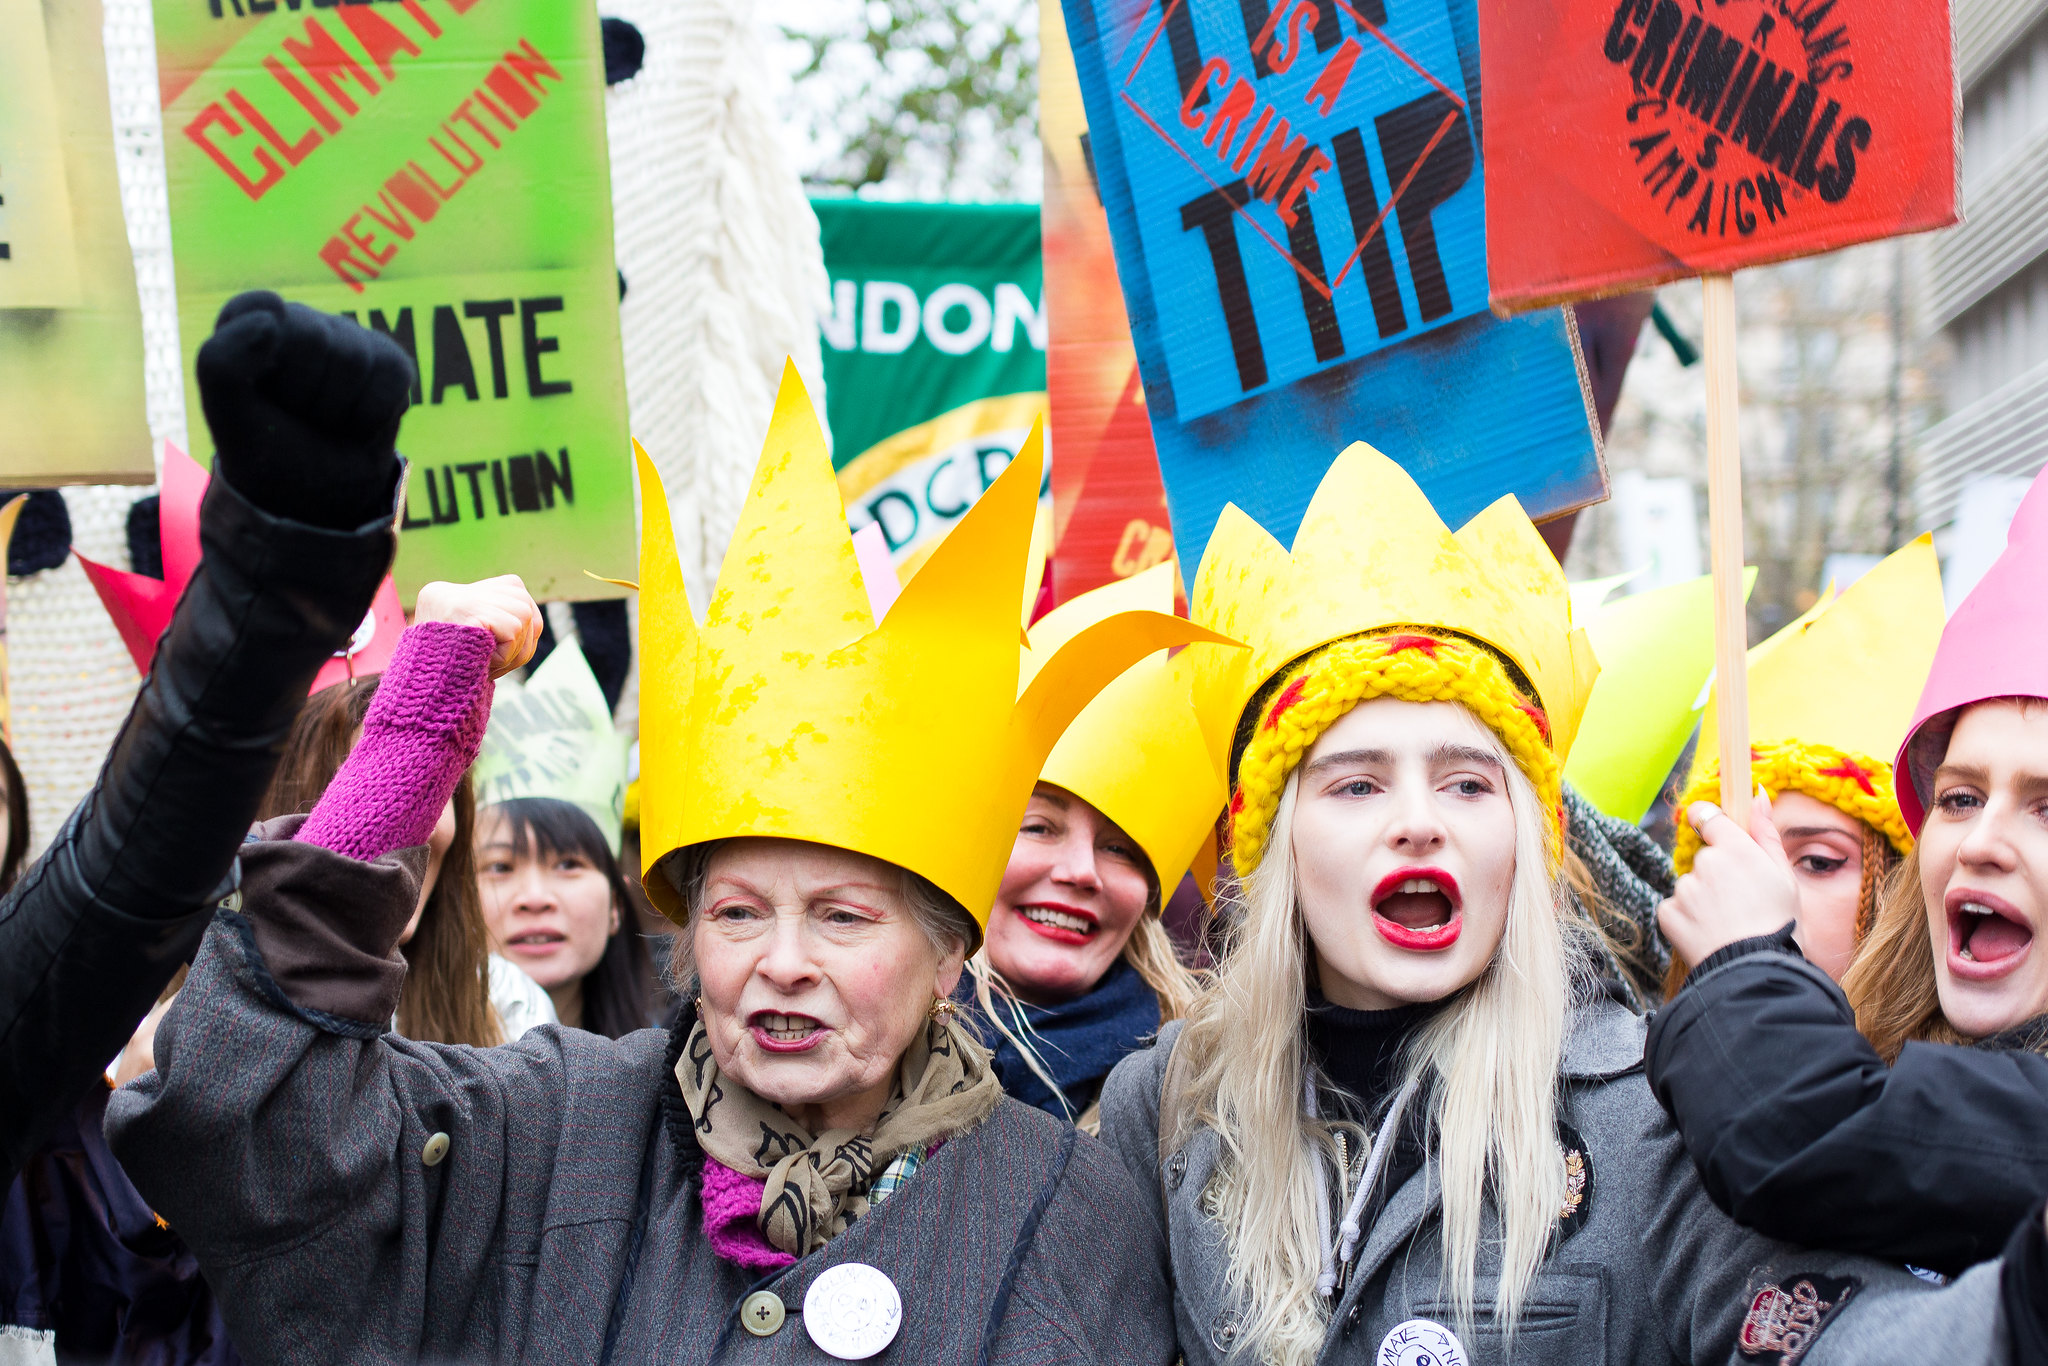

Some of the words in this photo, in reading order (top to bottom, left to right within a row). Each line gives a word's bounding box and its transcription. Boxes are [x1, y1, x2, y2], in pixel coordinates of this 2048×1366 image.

[182, 0, 480, 201] CLIMA
[1250, 0, 1320, 74] IS
[1304, 36, 1363, 118] A
[318, 37, 564, 293] REVOLUTION
[1179, 57, 1333, 229] CRIME
[1626, 98, 1787, 236] CAMPAIGN
[1180, 89, 1475, 392] TTIP
[341, 296, 573, 405] MATE
[1383, 1324, 1419, 1366] MATE
